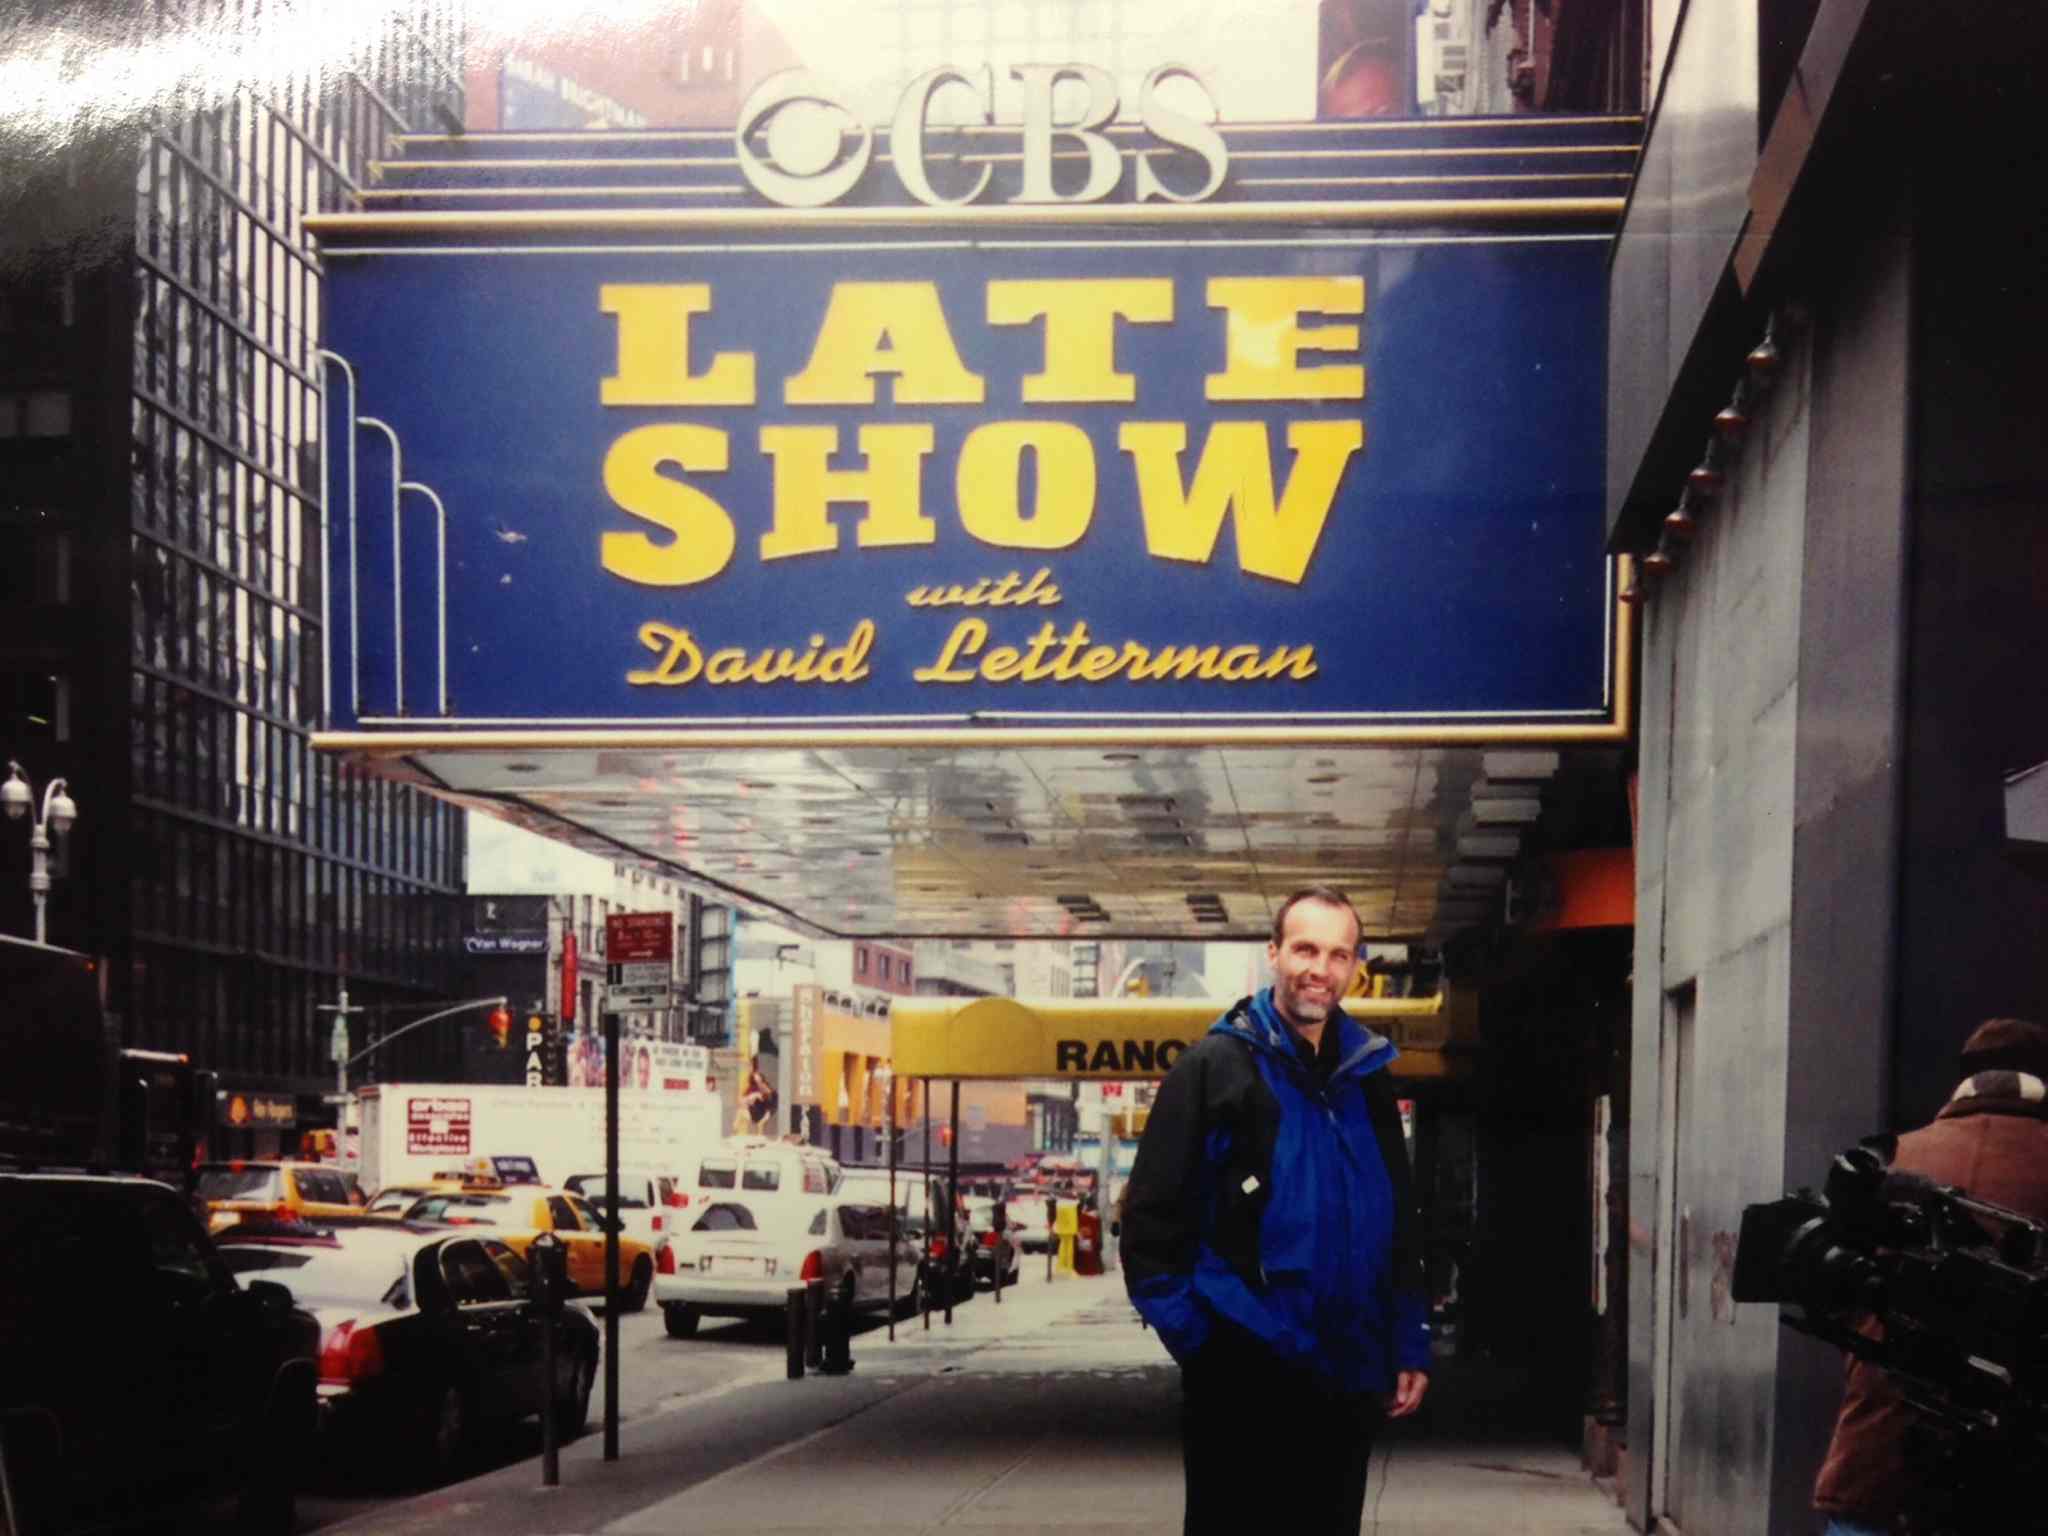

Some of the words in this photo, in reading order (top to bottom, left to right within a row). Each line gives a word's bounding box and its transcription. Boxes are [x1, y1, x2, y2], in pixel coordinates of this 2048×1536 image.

[889, 61, 1230, 206] CBS
[598, 273, 1367, 404] LATE
[599, 418, 1365, 586] SHOW
[626, 617, 876, 687] David
[913, 616, 1319, 684] Letterman
[905, 567, 1062, 608] with
